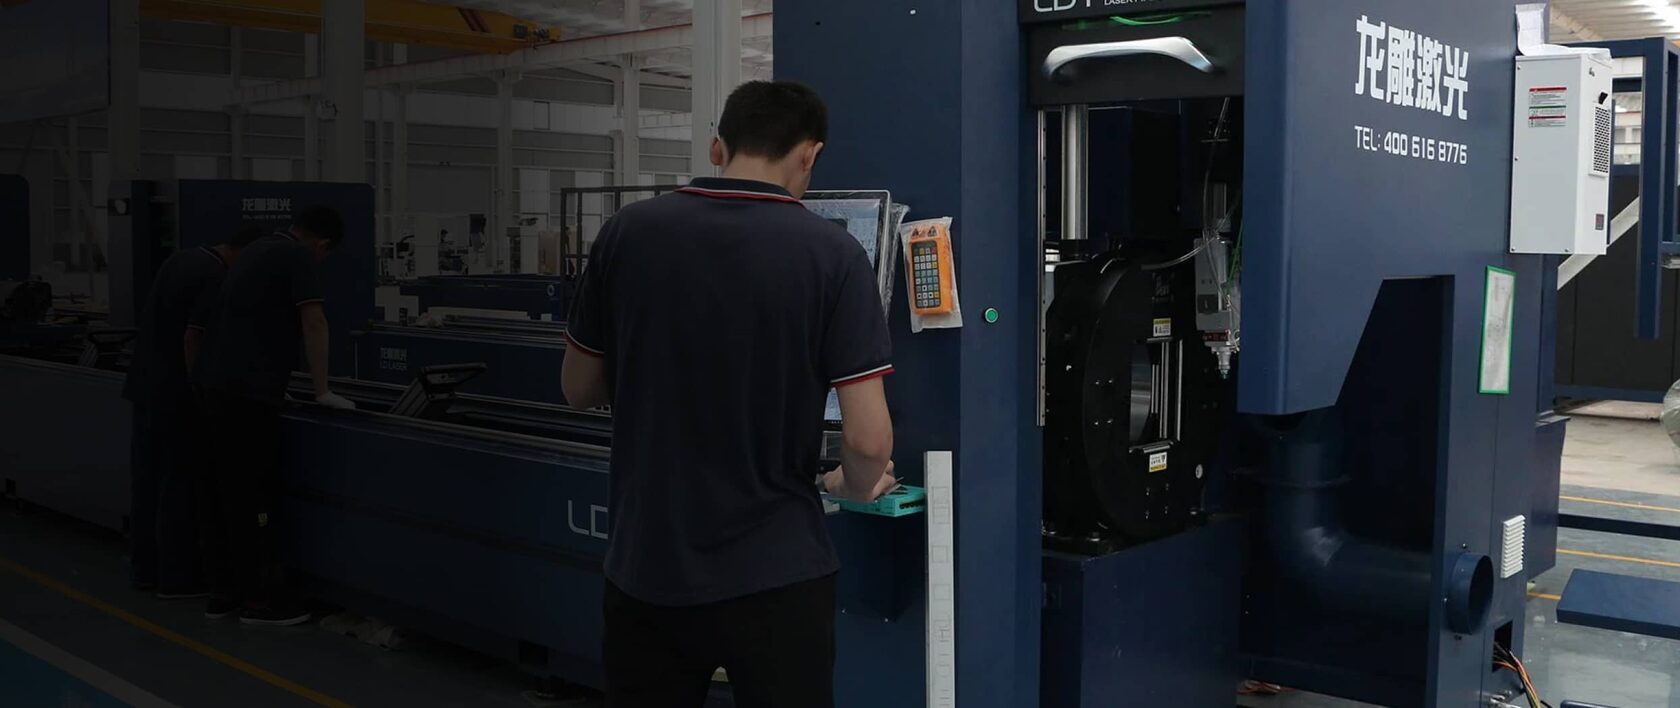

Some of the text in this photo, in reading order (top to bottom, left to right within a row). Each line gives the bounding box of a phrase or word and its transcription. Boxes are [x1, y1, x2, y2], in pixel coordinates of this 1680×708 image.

[1355, 15, 1469, 120] 龙雕激光
[1354, 126, 1467, 165] TEL: 400 616 8776
